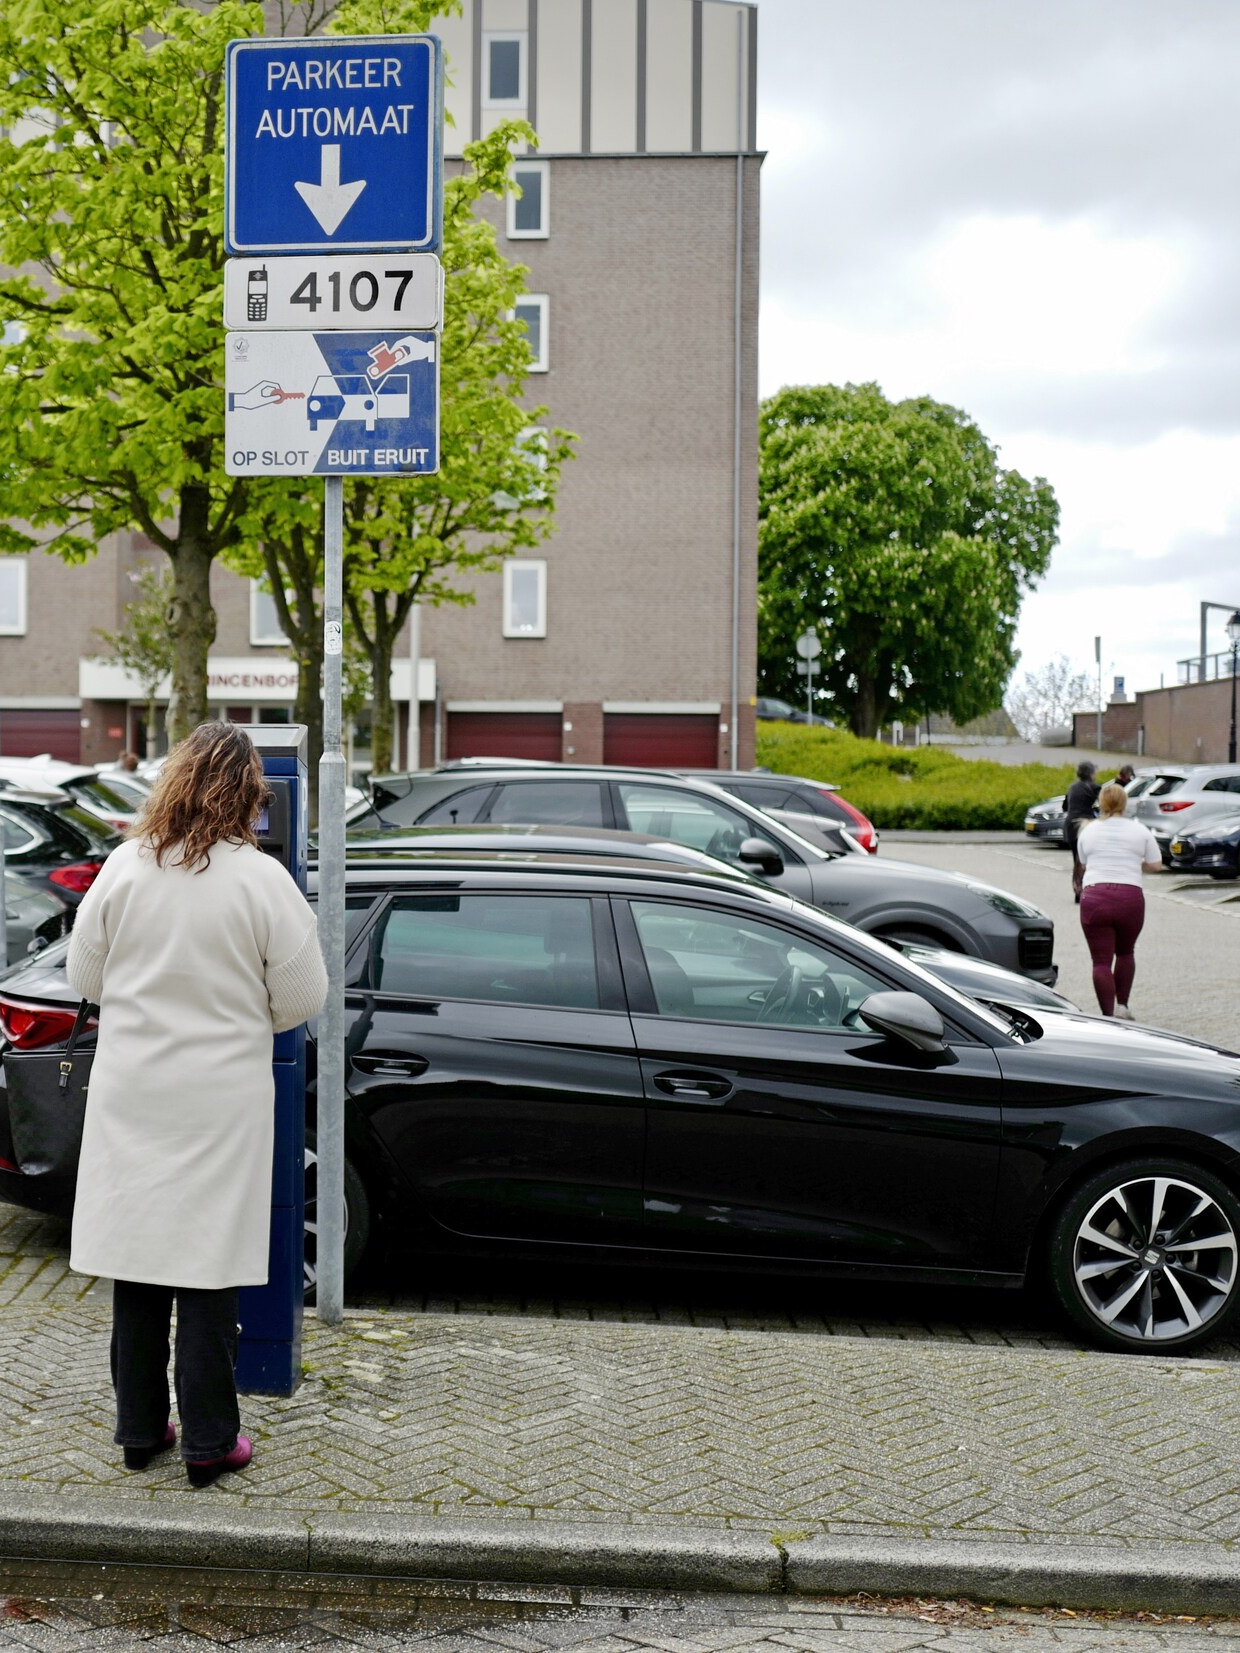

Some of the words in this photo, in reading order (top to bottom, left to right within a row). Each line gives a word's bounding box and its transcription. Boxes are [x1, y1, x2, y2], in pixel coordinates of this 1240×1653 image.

[266, 58, 402, 91] PARKEER
[255, 104, 414, 138] AUTOMAAT
[289, 270, 413, 313] 4107
[232, 450, 257, 466] OP
[262, 450, 309, 466] SLOT
[327, 449, 370, 466] BUIT
[374, 448, 429, 465] ERUIT
